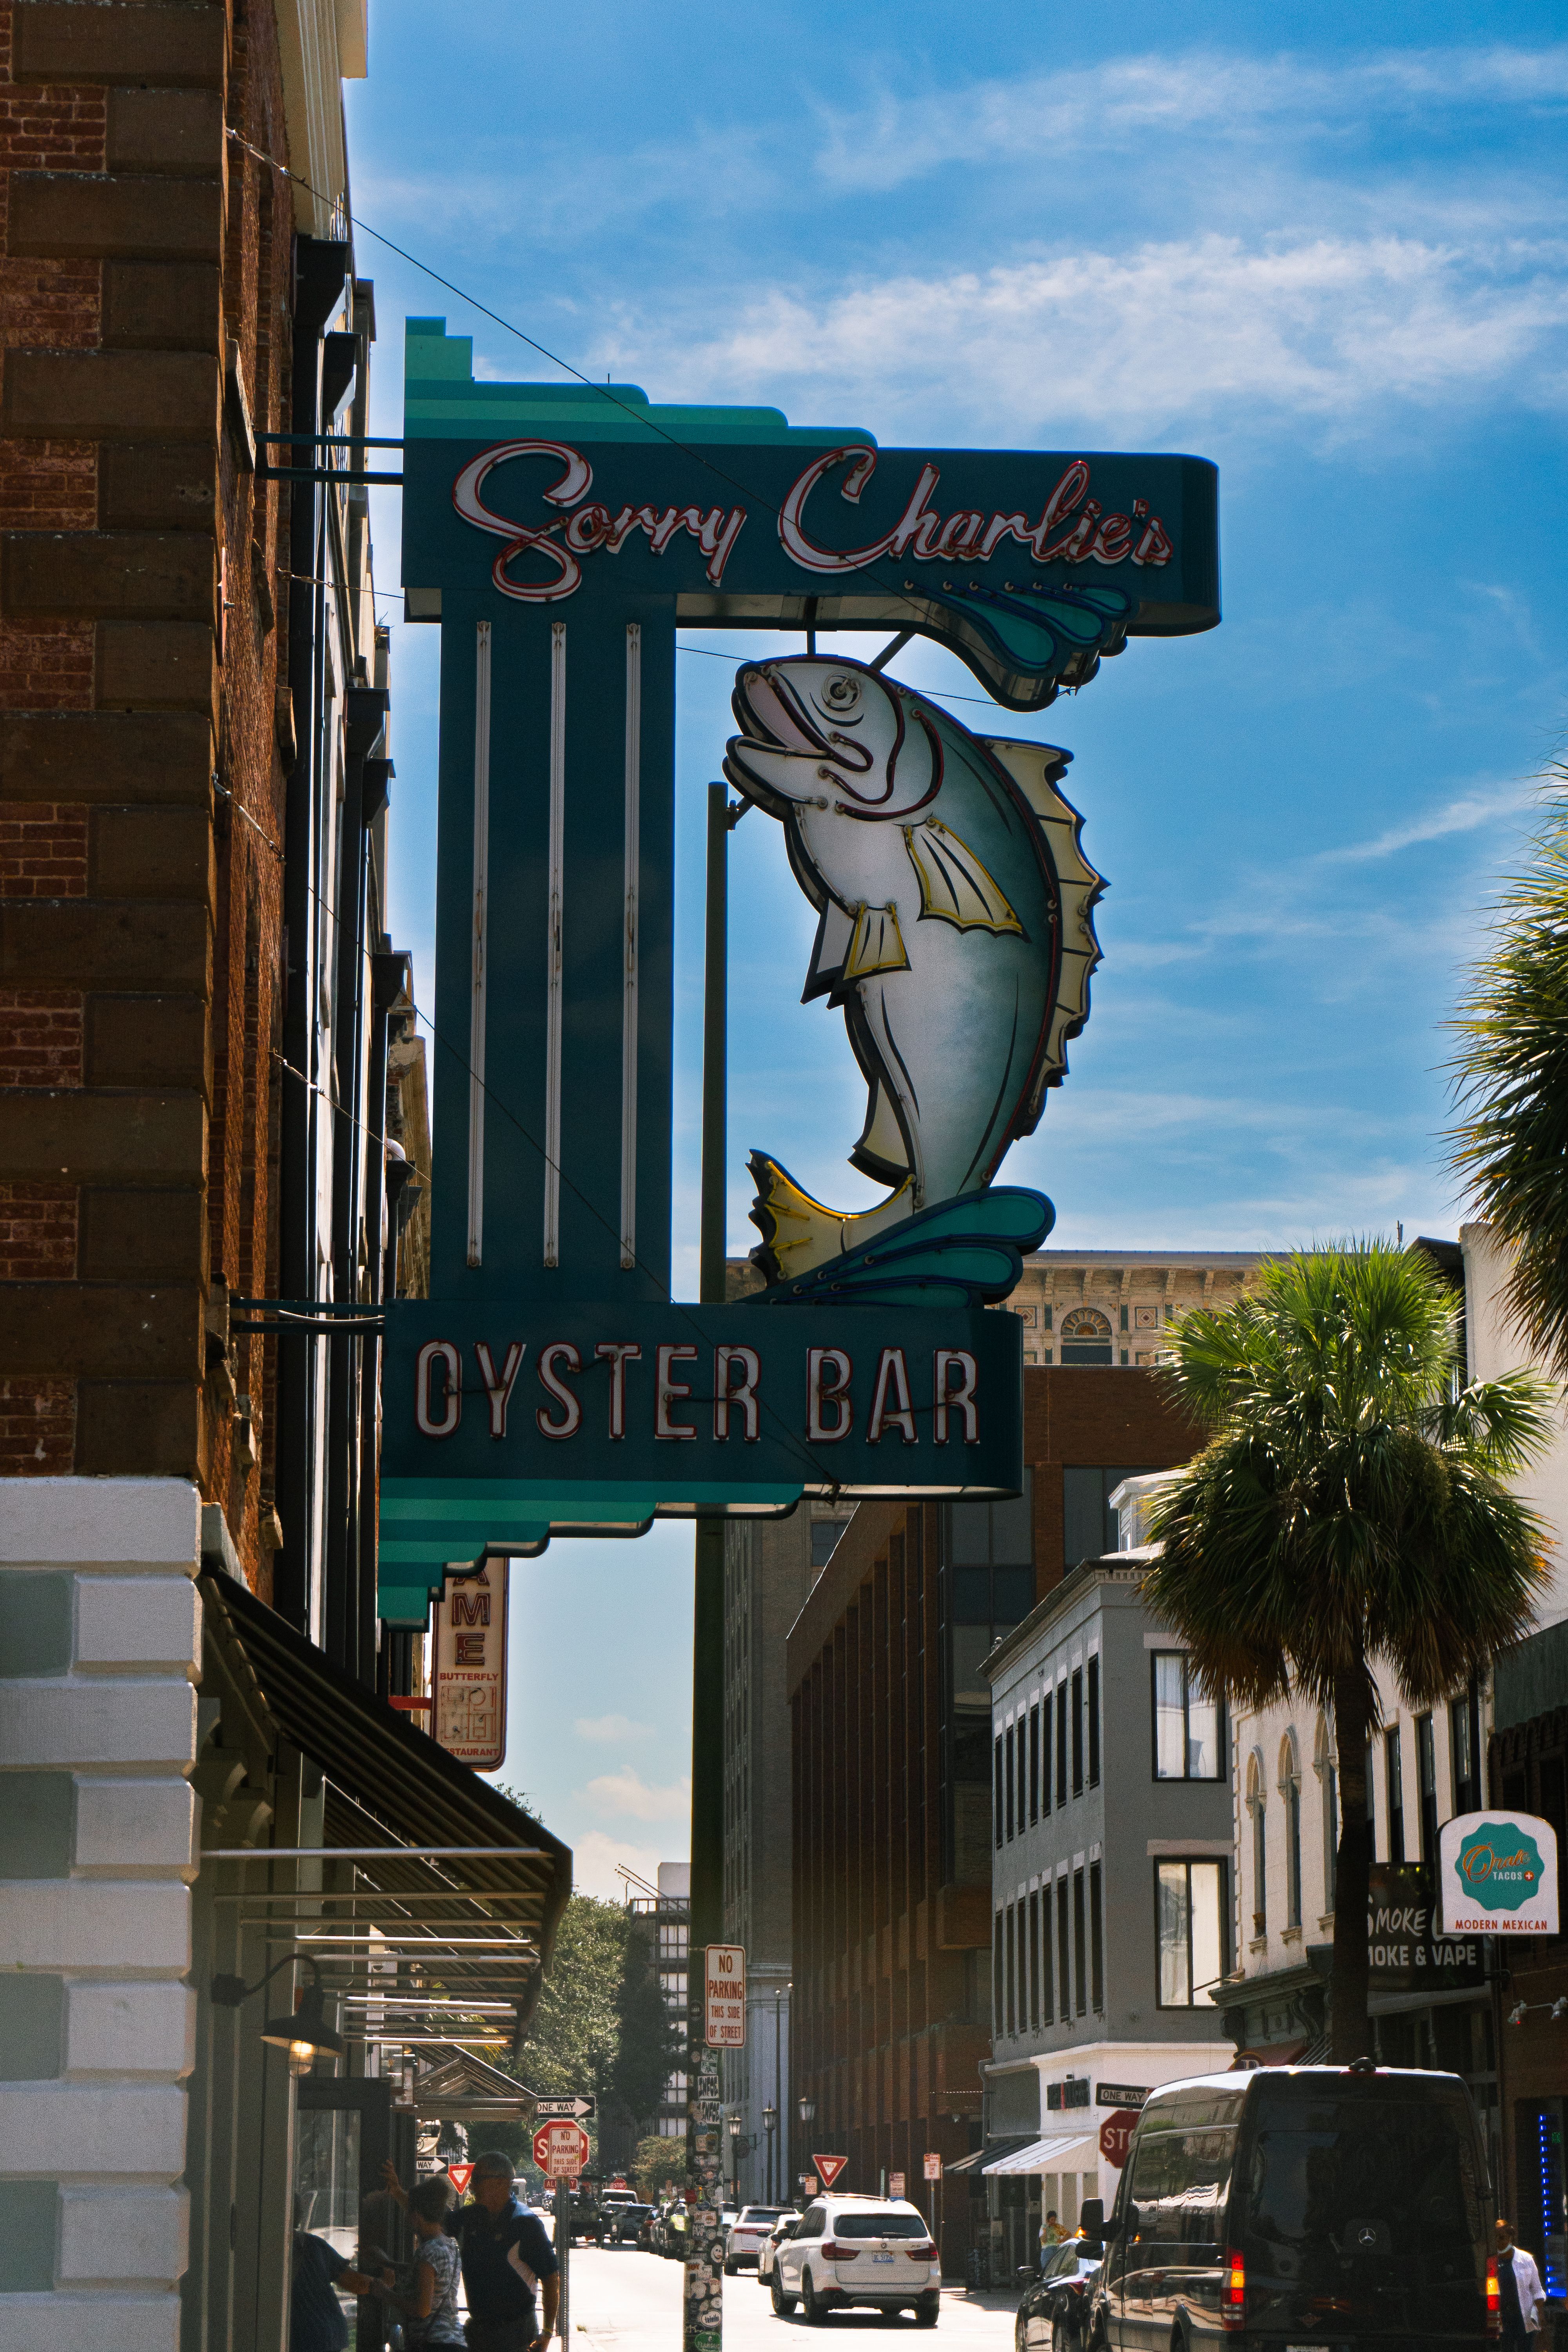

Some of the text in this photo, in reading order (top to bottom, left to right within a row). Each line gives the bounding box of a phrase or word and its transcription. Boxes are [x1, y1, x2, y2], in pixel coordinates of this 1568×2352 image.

[452, 438, 1173, 602] Sorry Charlie's
[415, 1339, 980, 1445] OYSTER BAR
[1493, 1871, 1522, 1880] TACOS
[1455, 1920, 1547, 1930] MODERN MEXICAN
[1415, 1945, 1426, 1965] &
[1432, 1945, 1476, 1965] VAPE
[719, 1955, 733, 1973] NO
[708, 1980, 742, 1999] PARKING
[711, 2005, 740, 2018] THIS SIDE
[710, 2025, 741, 2038] OF STREET
[1103, 2090, 1143, 2102] ONE WAY
[557, 2103, 575, 2111] WAY
[561, 2131, 570, 2140] NO
[552, 2145, 579, 2154] PARKING
